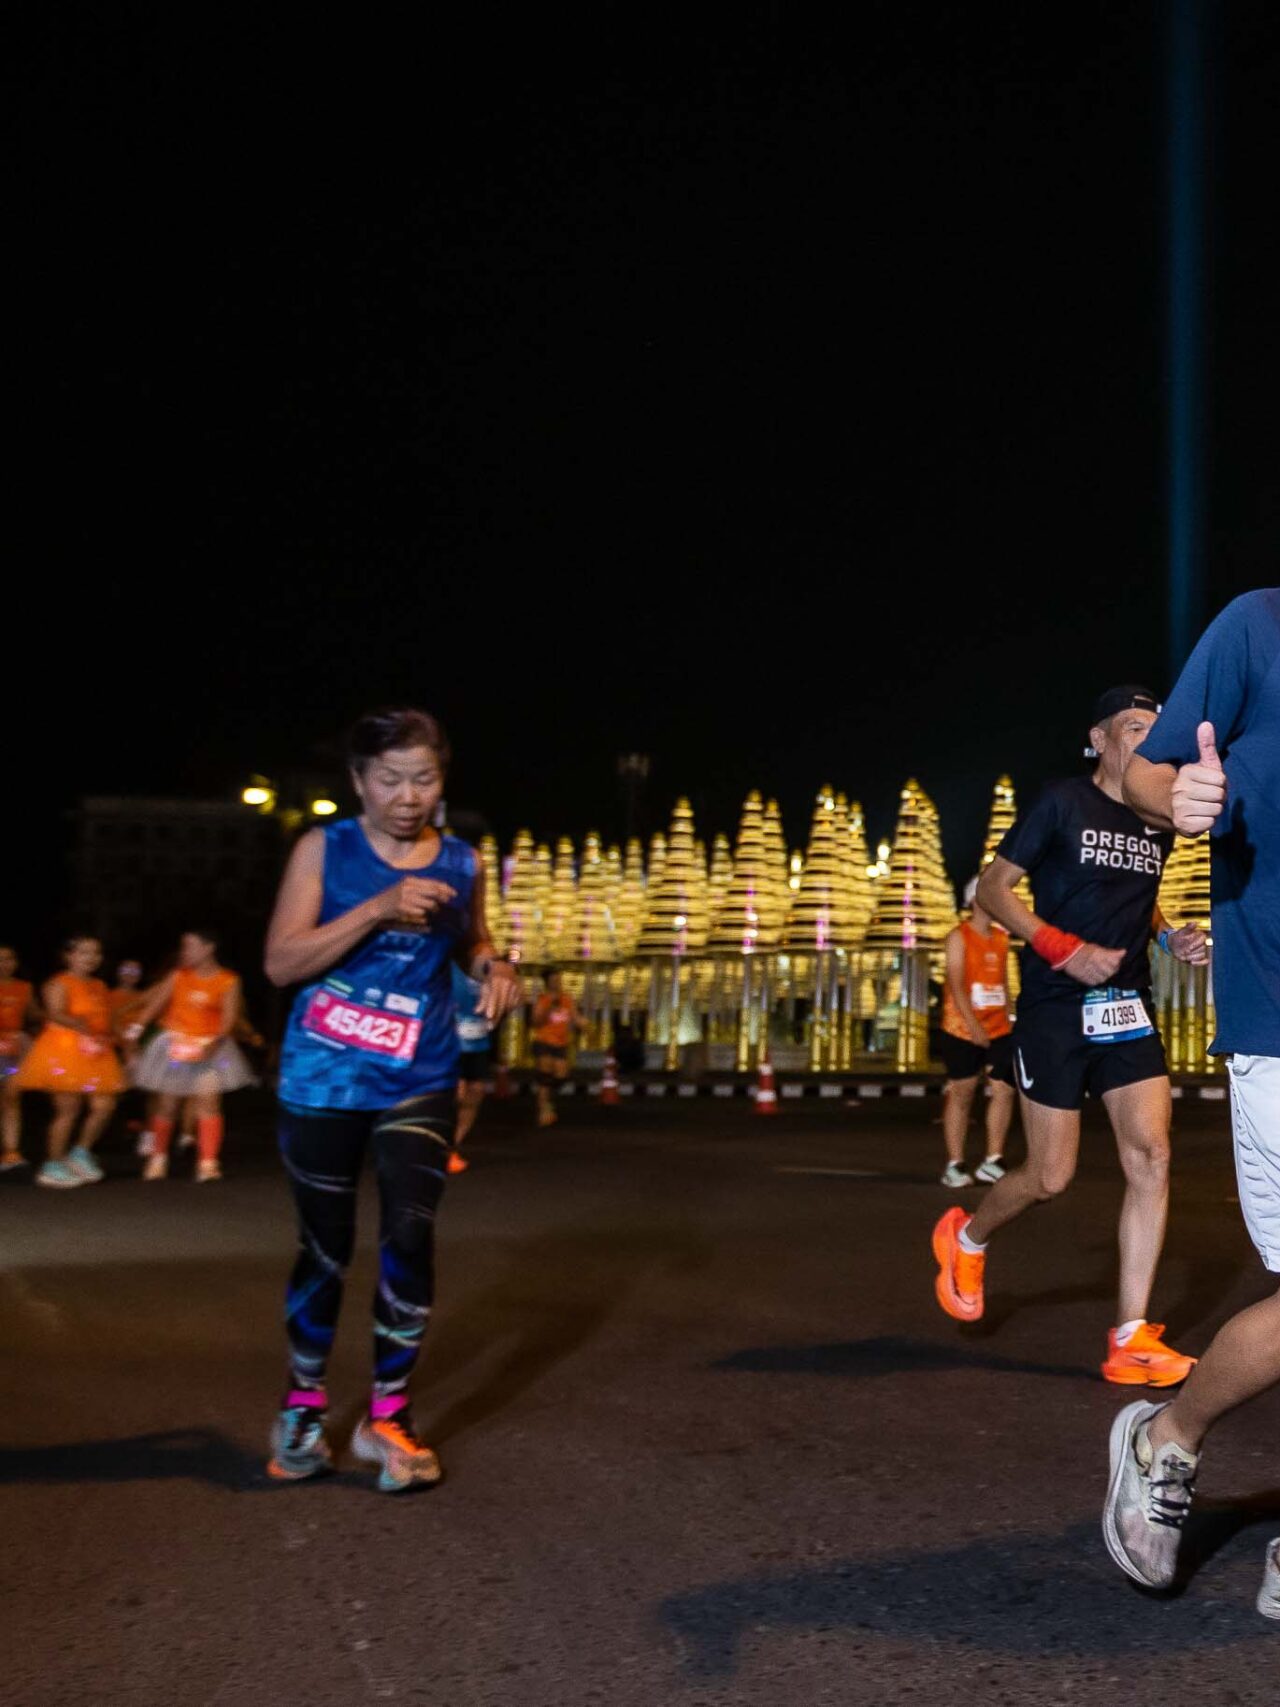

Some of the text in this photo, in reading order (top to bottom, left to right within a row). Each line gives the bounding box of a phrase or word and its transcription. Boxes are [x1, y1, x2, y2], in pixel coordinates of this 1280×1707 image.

[1081, 829, 1162, 860] OREGON
[1080, 847, 1162, 876] PROJECT
[323, 1005, 405, 1048] 45423
[1101, 1005, 1137, 1028] 41399
